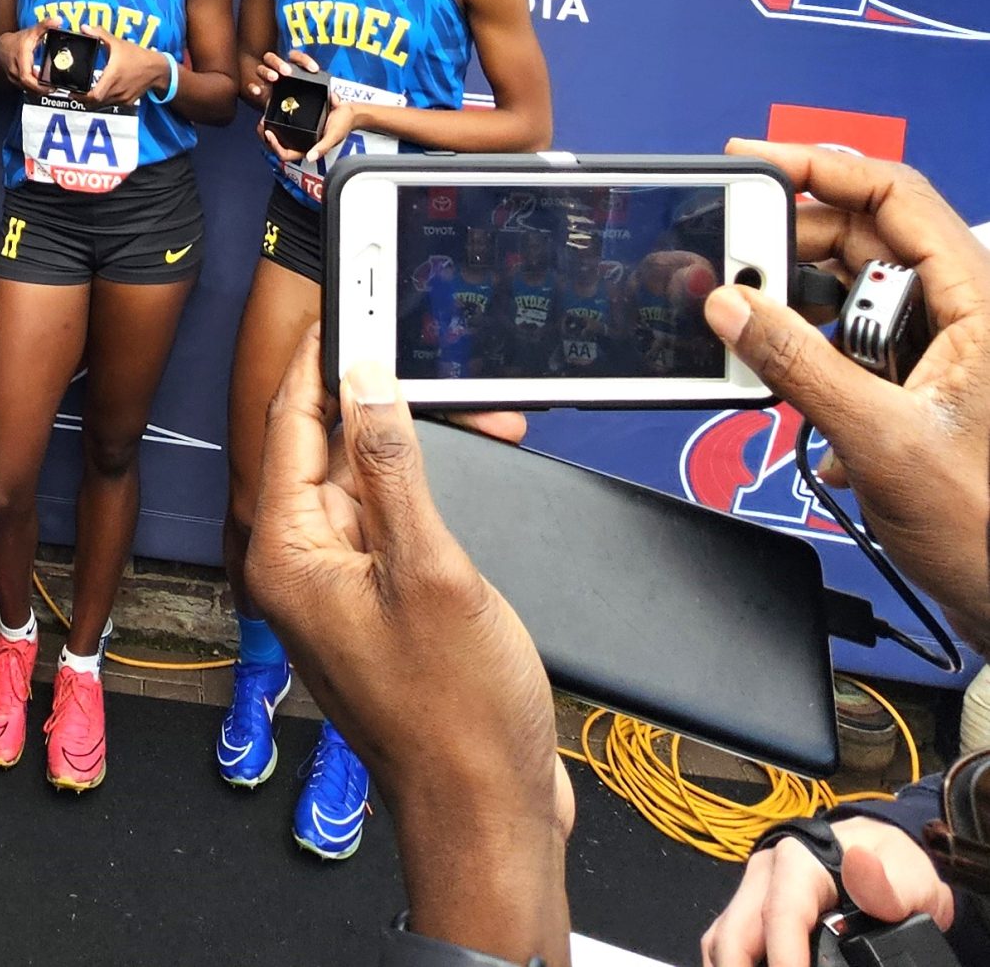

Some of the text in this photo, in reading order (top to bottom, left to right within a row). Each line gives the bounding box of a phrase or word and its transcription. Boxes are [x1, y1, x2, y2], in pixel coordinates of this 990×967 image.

[282, 0, 411, 67] HYDEL
[41, 96, 69, 109] Dream
[70, 100, 86, 111] On.
[333, 85, 375, 101] PENN
[38, 113, 118, 168] AA
[1, 217, 26, 259] H
[568, 342, 591, 359] AA
